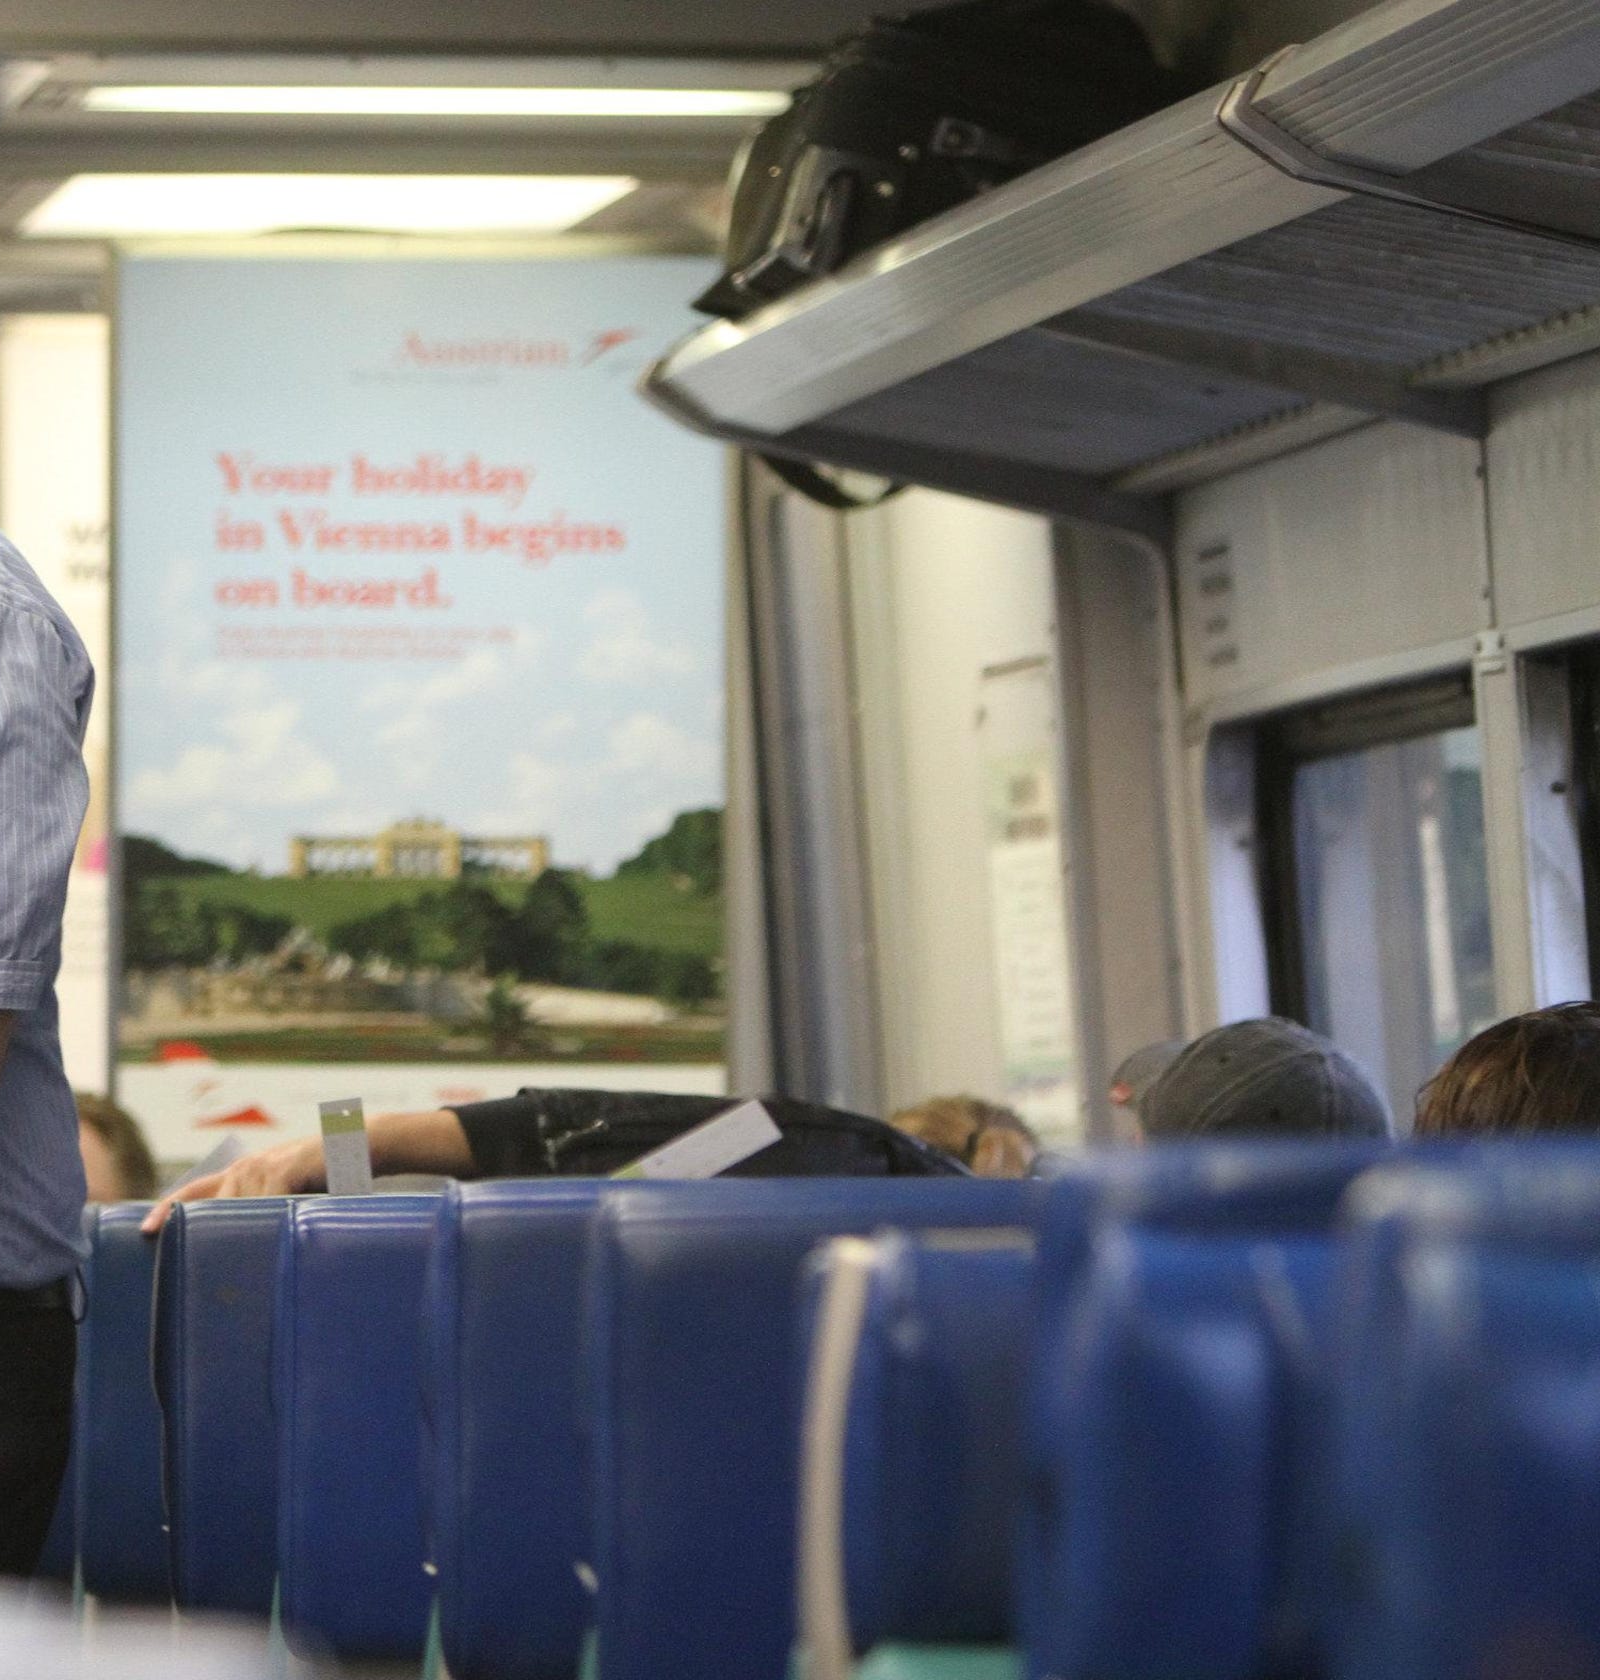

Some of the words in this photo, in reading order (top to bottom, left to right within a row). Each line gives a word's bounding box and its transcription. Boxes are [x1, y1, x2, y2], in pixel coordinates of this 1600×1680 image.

[399, 331, 569, 369] Austrian
[215, 452, 337, 495] Your
[351, 452, 535, 510] holiday
[215, 508, 265, 551] in
[276, 509, 450, 552] Vienna
[462, 508, 626, 569] begins
[214, 578, 280, 609] on
[291, 565, 455, 610] board.
